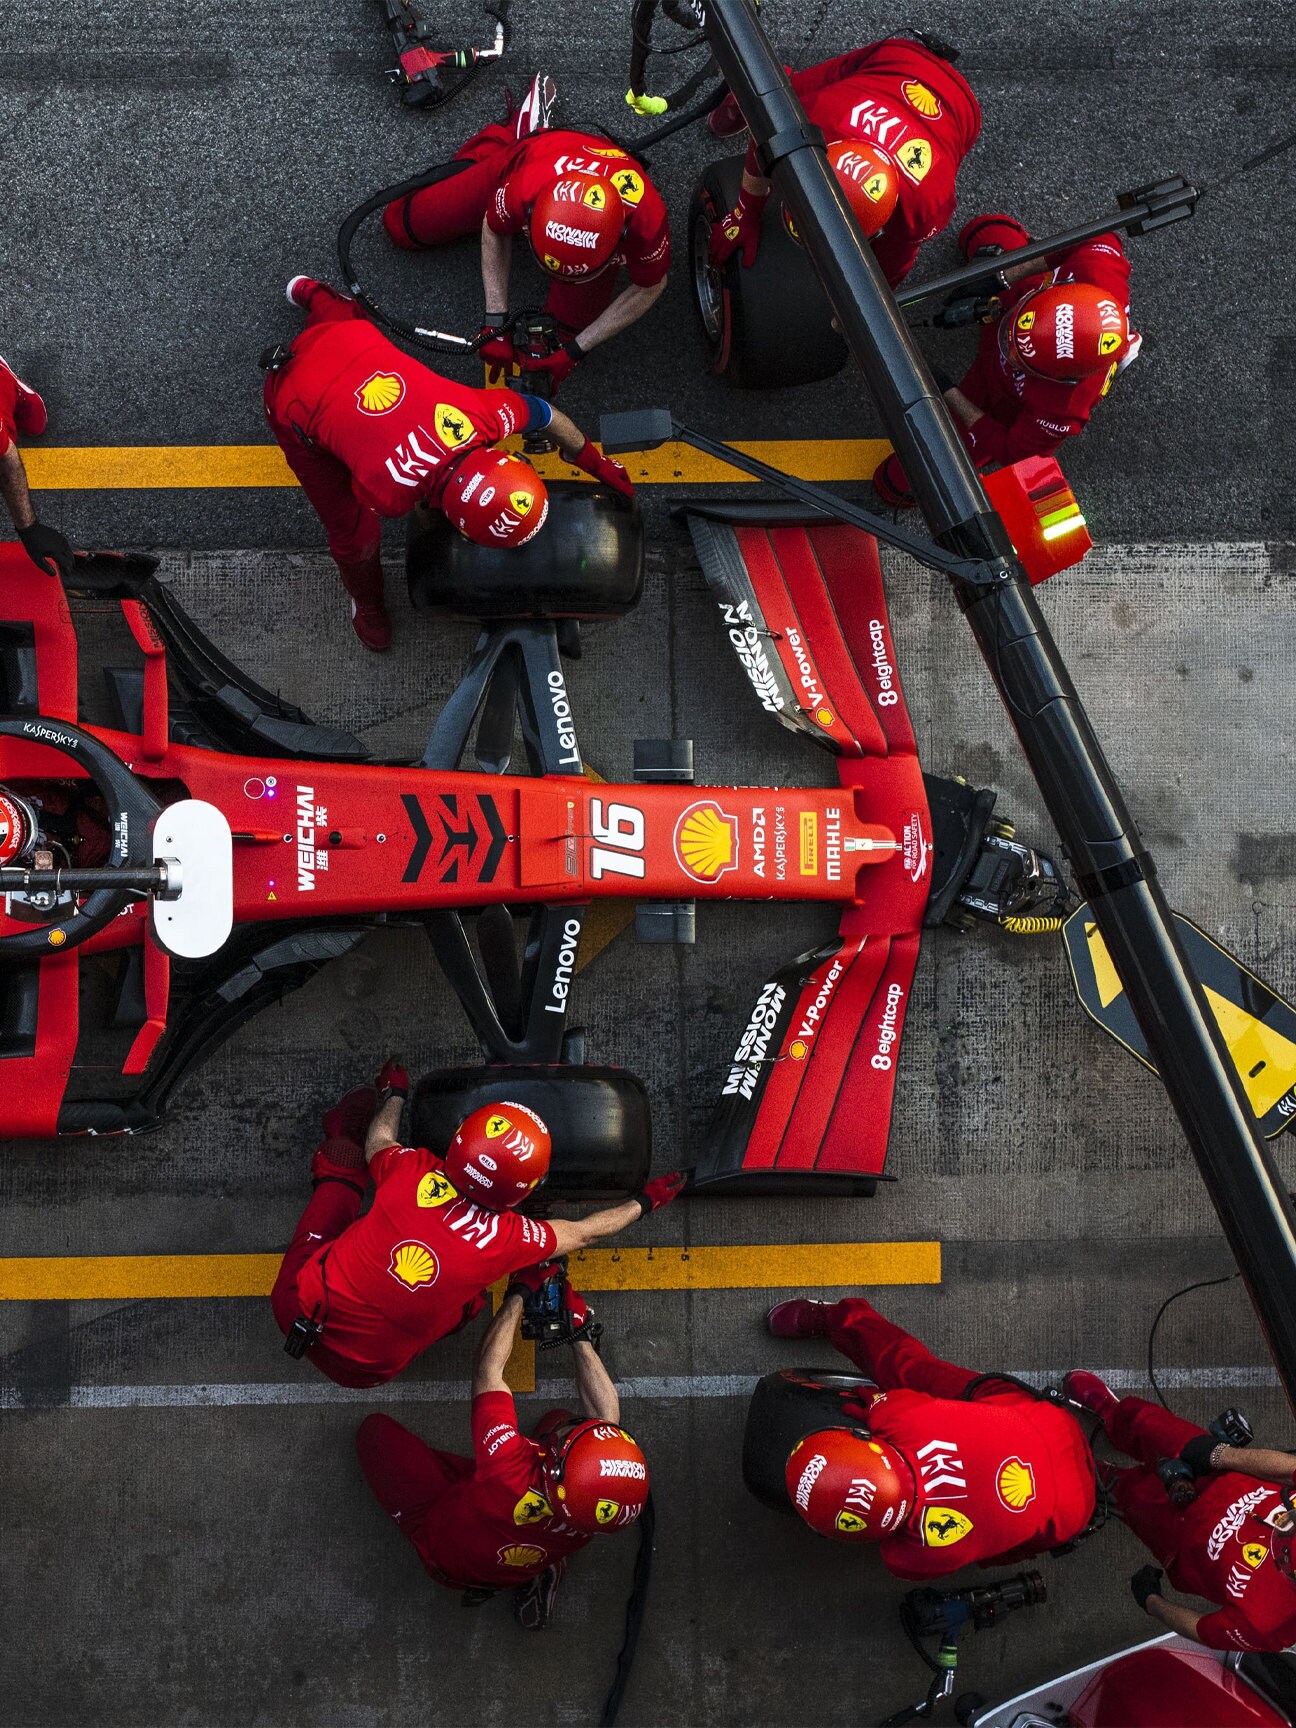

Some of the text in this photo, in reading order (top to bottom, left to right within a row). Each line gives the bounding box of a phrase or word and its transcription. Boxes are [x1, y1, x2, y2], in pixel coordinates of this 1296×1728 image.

[546, 220, 599, 242] WINNOW
[546, 229, 596, 248] MISSION
[718, 602, 777, 712] MISSION
[736, 599, 785, 709] WINNOW
[785, 627, 823, 708] V-Power
[869, 619, 893, 690] eightcap
[24, 722, 73, 746] KASPERSKY
[546, 671, 581, 765] Lenovo
[120, 812, 128, 857] WEICHAI
[296, 785, 315, 892] WEICHAI
[589, 797, 646, 880] 16
[752, 827, 766, 878] AMD
[774, 818, 787, 881] KASPERSKY
[804, 817, 814, 870] PIRELLI
[826, 808, 841, 880] MAHLE
[903, 825, 912, 857] ACTION
[545, 919, 581, 1014] Lenovo
[798, 960, 844, 1036] V-Power
[878, 983, 903, 1054] eightcap
[488, 1430, 517, 1456] HUBLOT
[796, 1454, 823, 1504] MISSION
